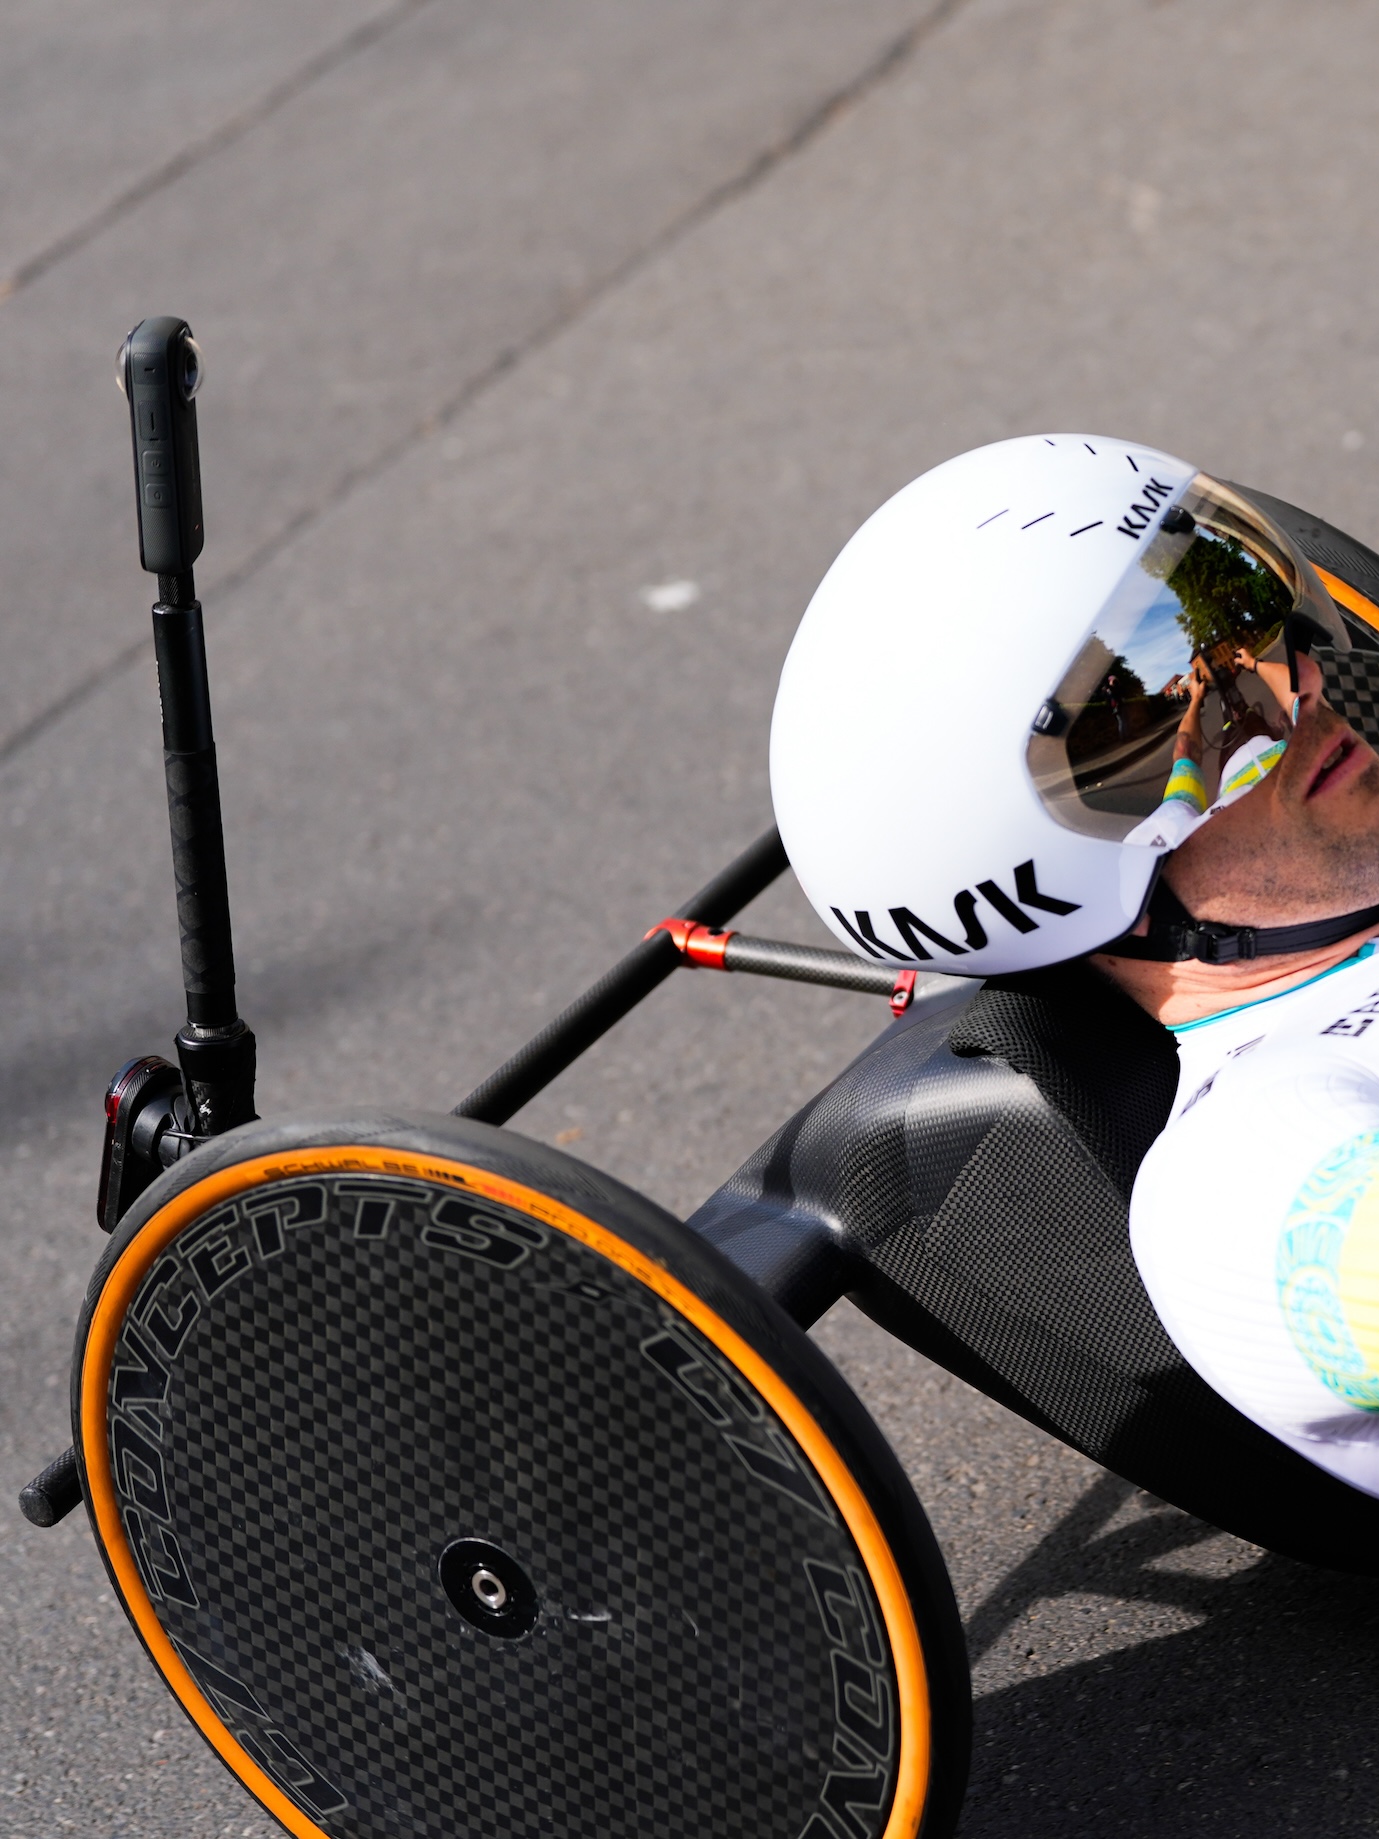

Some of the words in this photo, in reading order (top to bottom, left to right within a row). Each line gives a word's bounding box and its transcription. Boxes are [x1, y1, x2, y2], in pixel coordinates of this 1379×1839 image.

[1117, 477, 1174, 540] KASK
[830, 859, 1083, 961] KASK
[262, 1156, 420, 1177] SCHWALBE
[111, 1180, 550, 1609] CONCEPTS
